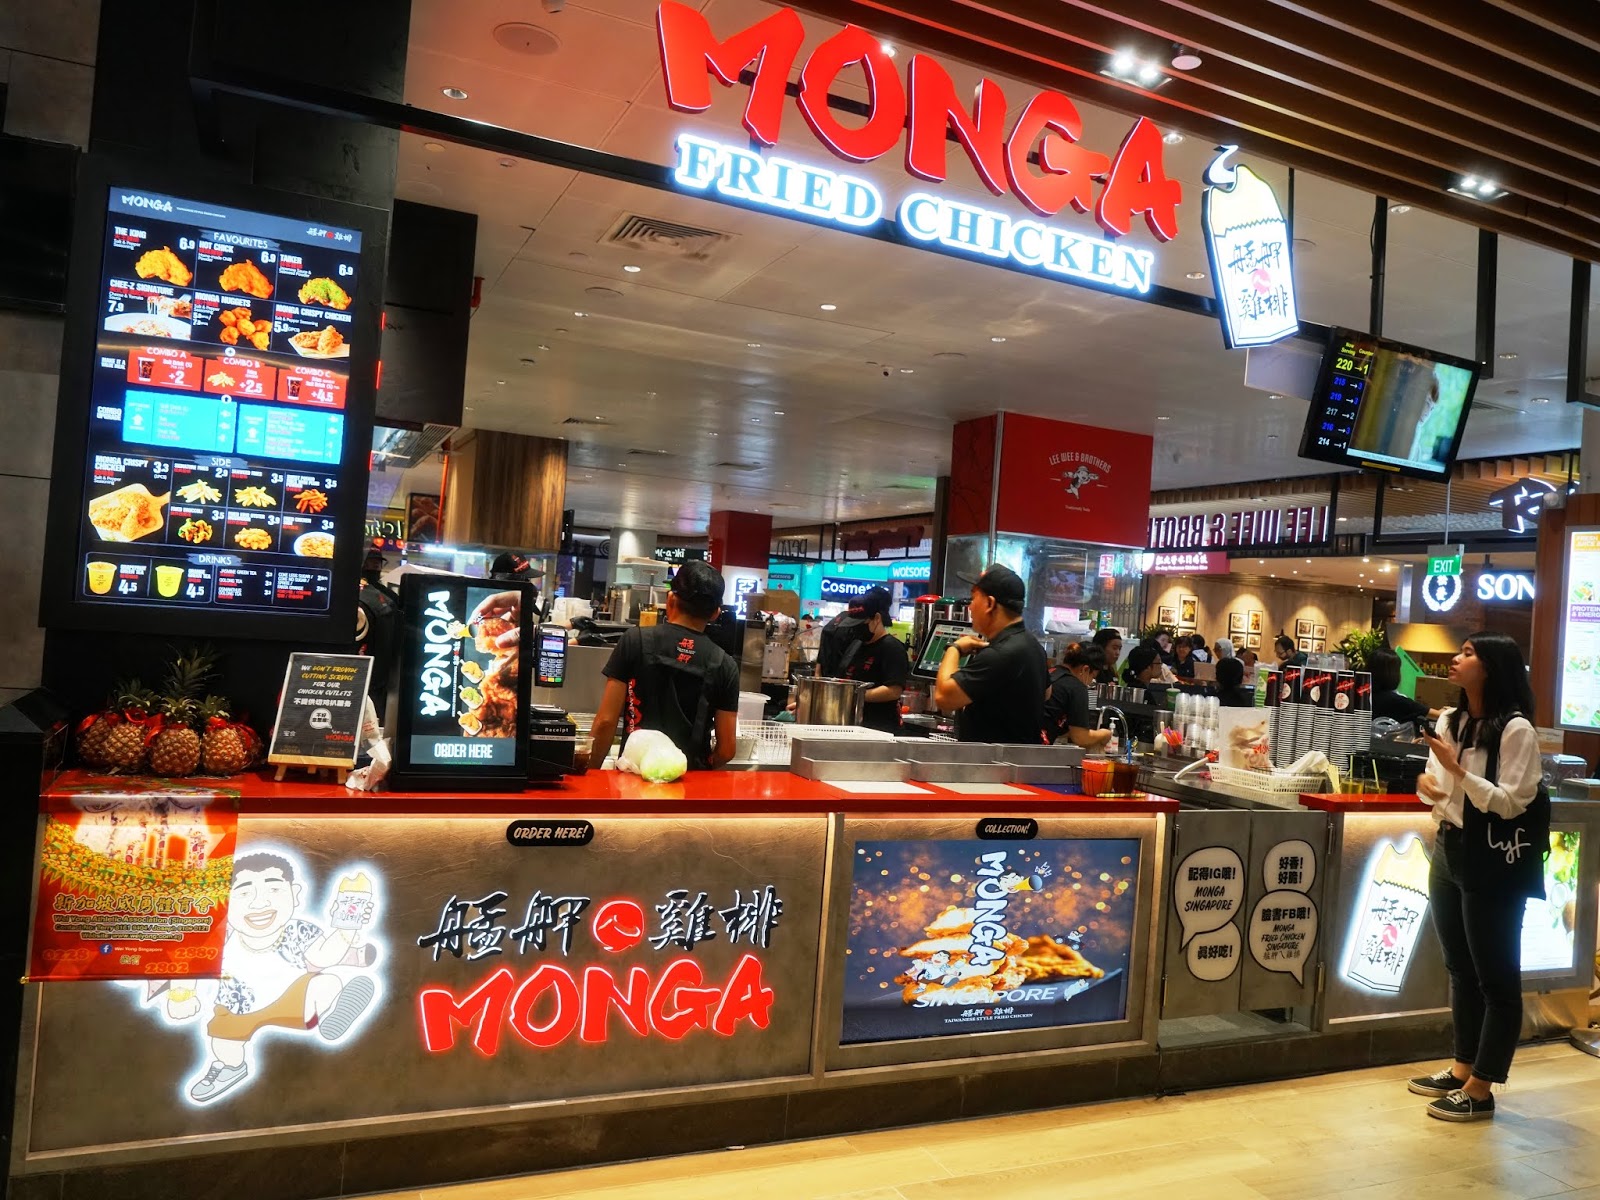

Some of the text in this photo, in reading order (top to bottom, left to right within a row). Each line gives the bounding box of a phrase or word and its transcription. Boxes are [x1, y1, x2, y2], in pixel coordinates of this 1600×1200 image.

[655, 1, 1182, 242] MONGA
[122, 195, 172, 212] MONGA
[678, 138, 1151, 290] FRIED CHICKEN
[179, 237, 195, 250] 6.9
[213, 232, 268, 248] FAVOURITES
[260, 251, 276, 264] 6.9
[338, 264, 354, 276] 6.9
[136, 283, 174, 296] SIGNATURE
[108, 300, 124, 312] 7.9
[221, 296, 251, 308] NUGGETS
[301, 308, 324, 318] CRISPY
[324, 312, 352, 322] CHICKEN
[274, 321, 288, 332] 5.9
[146, 346, 178, 358] COMBO
[223, 358, 252, 367] COMBO
[1336, 358, 1368, 374] 220 1
[295, 367, 331, 378] COMBO C
[1326, 408, 1354, 420] 217 2
[1318, 437, 1330, 446] 214
[152, 461, 169, 474] 3.3
[211, 458, 231, 467] SIDE
[1049, 454, 1060, 466] LEE
[1060, 452, 1074, 462] WEE
[1080, 453, 1112, 474] BROTHERS
[271, 472, 284, 484] 3.5
[324, 478, 338, 489] 3.5
[212, 510, 225, 521] 3.5
[198, 554, 232, 565] DRINKS
[893, 567, 931, 578] watsons
[1434, 560, 1454, 573] EXIT
[118, 579, 138, 594] 4.5
[186, 583, 204, 598] 4.5
[419, 590, 455, 716] MONGA
[302, 672, 328, 680] CUTTING
[298, 688, 324, 696] CHICKEN
[434, 742, 493, 758] ORDER HERE
[513, 825, 588, 839] ORDER HERE!
[984, 822, 1031, 834] COLLECTION!
[1487, 822, 1531, 864] lyf
[1194, 886, 1226, 898] MONGA
[968, 851, 1008, 967] MONGA
[1184, 899, 1234, 912] SINGAPORE
[72, 916, 91, 924] Yong
[123, 916, 168, 924] Association
[168, 917, 212, 925] (Singapore)
[1272, 924, 1295, 932] MONGA
[1261, 933, 1305, 942] FRIED CHICKEN
[1266, 943, 1300, 951] SINGAPORE
[145, 962, 189, 974] 2802
[912, 987, 1058, 1008] SINGAPORE
[419, 953, 774, 1056] MONGA
